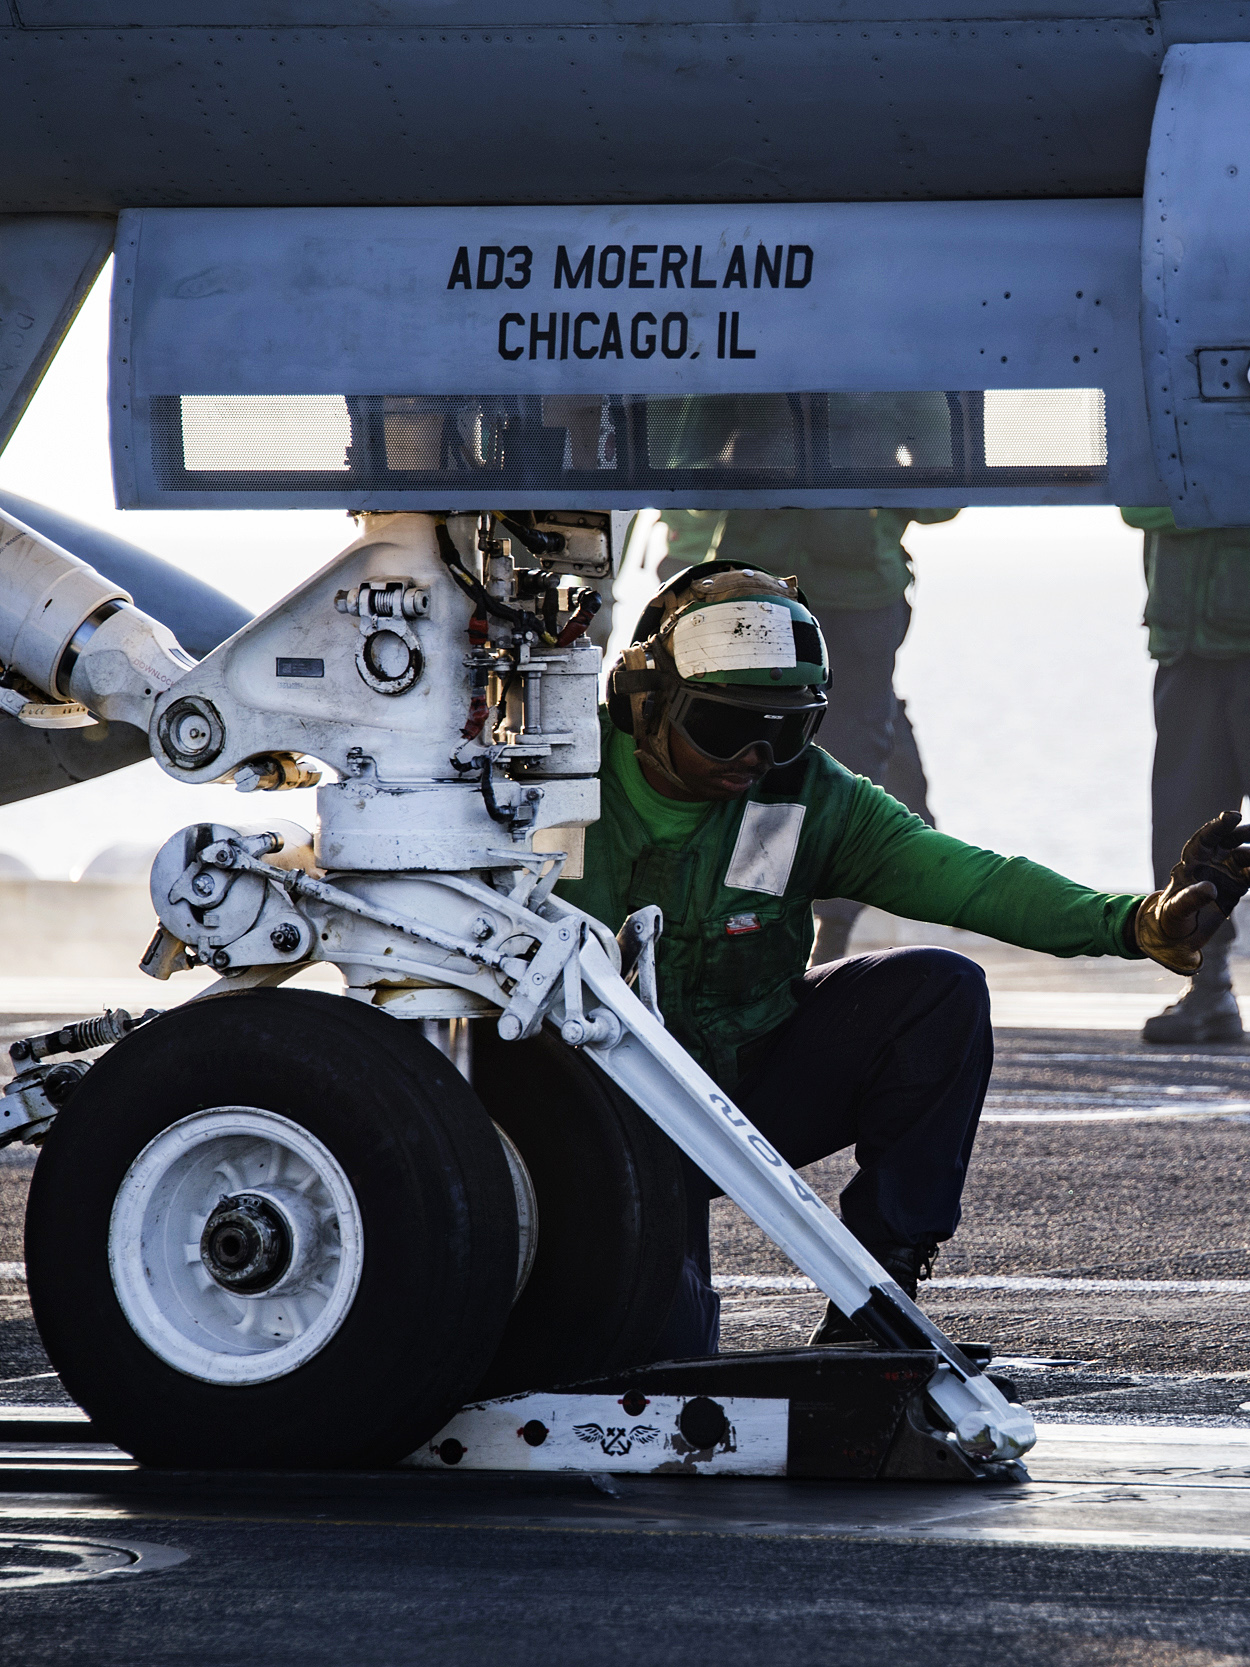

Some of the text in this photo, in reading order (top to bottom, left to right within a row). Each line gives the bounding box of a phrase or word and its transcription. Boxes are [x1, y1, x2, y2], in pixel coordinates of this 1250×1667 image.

[447, 245, 814, 289] AD3 MOERLAND
[498, 311, 756, 360] CHICAGO, IL
[709, 1093, 822, 1209] 204
